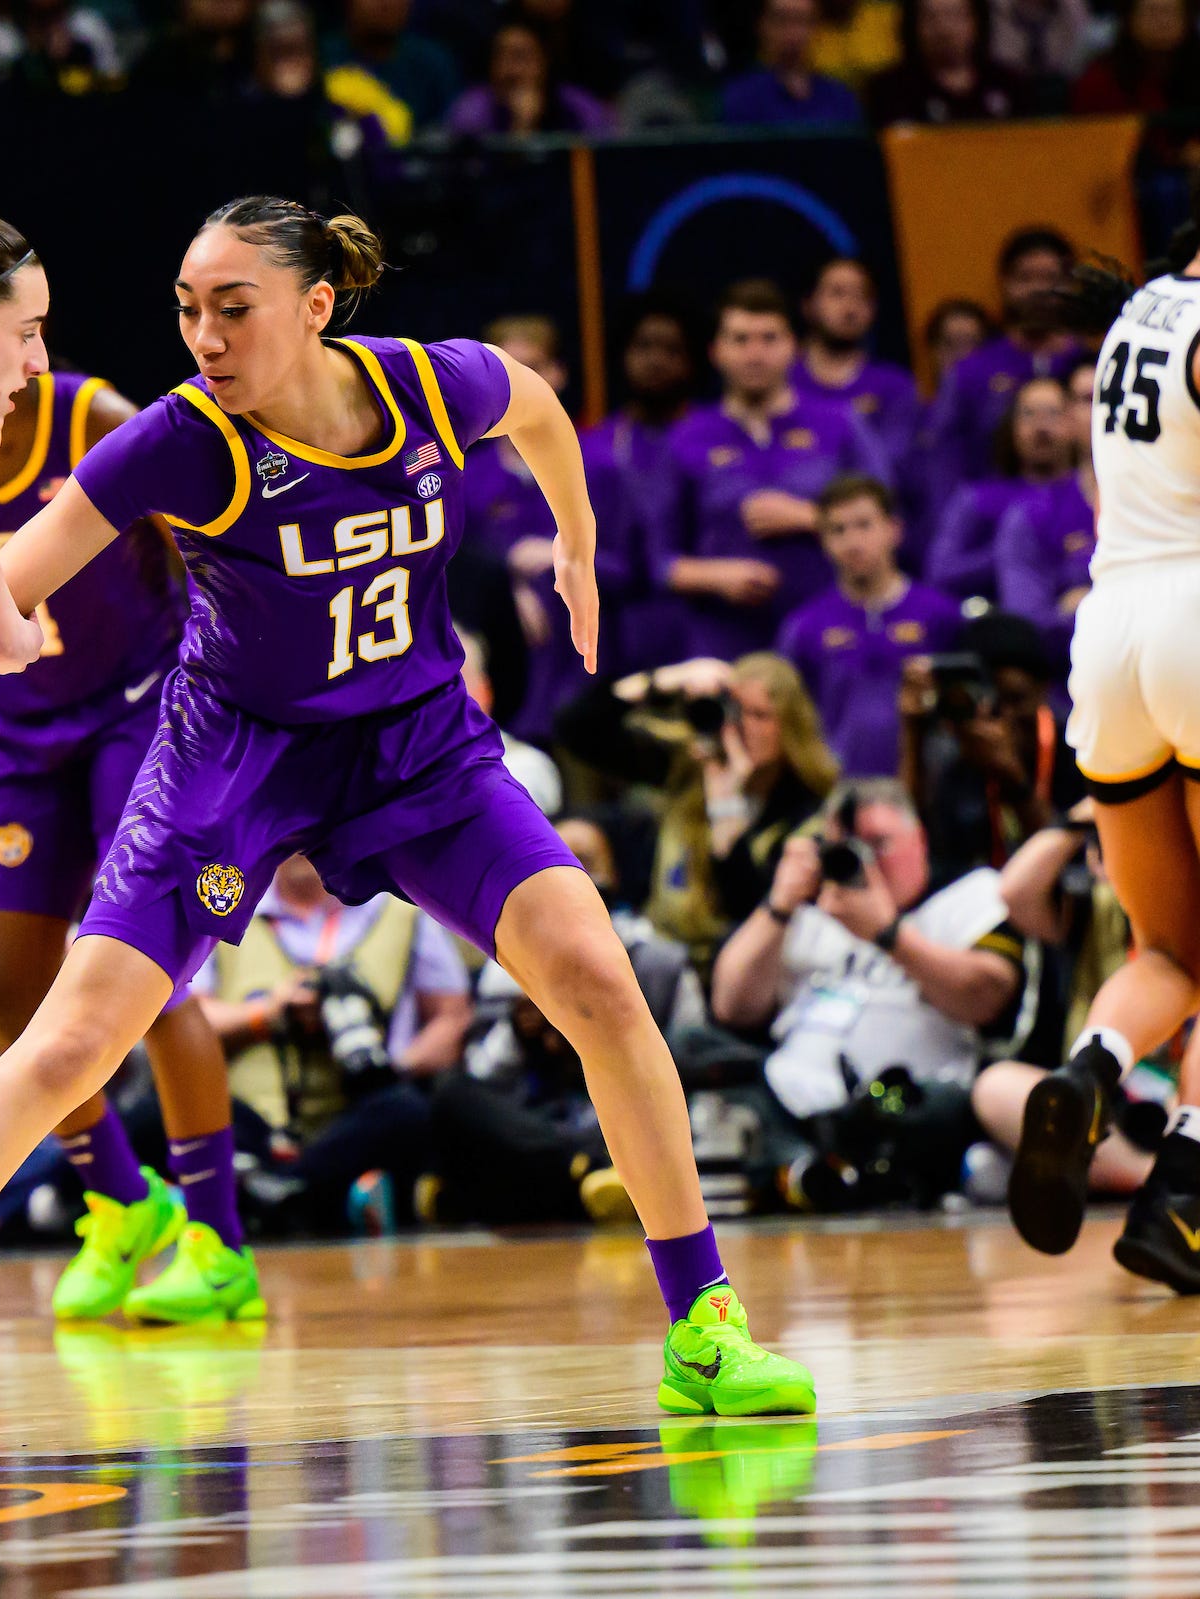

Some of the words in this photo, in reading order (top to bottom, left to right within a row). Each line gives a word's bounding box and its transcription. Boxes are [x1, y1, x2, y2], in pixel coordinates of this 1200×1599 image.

[1099, 341, 1169, 443] 45
[419, 475, 439, 497] SEC
[278, 498, 445, 577] LSU
[328, 566, 414, 680] 13
